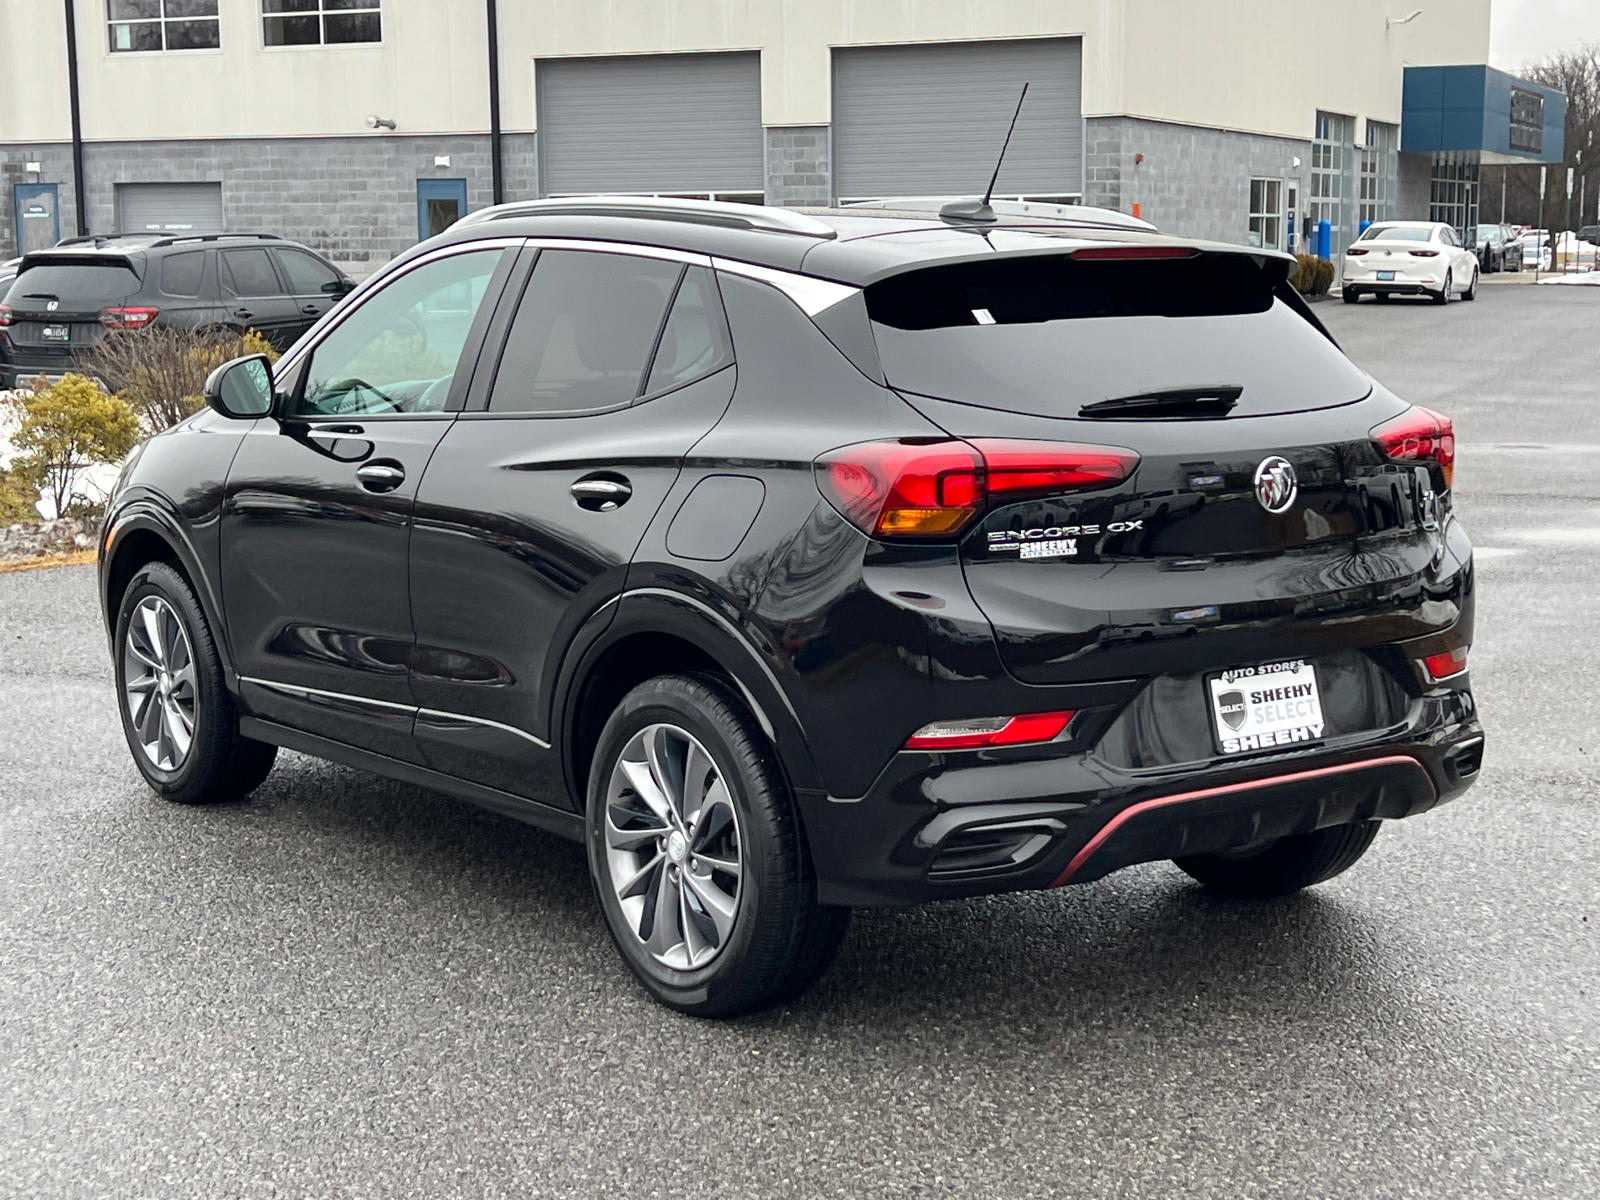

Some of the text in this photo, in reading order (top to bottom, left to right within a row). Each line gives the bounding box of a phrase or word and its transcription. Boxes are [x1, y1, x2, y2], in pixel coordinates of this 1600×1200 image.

[988, 520, 1143, 541] ENCORE GX
[1020, 539, 1077, 553] SHEEHY
[1221, 660, 1305, 680] AUTO STORES
[1251, 683, 1312, 704] SHEEHY
[1254, 699, 1315, 724] SELECT
[1222, 725, 1324, 753] SHEEHY
